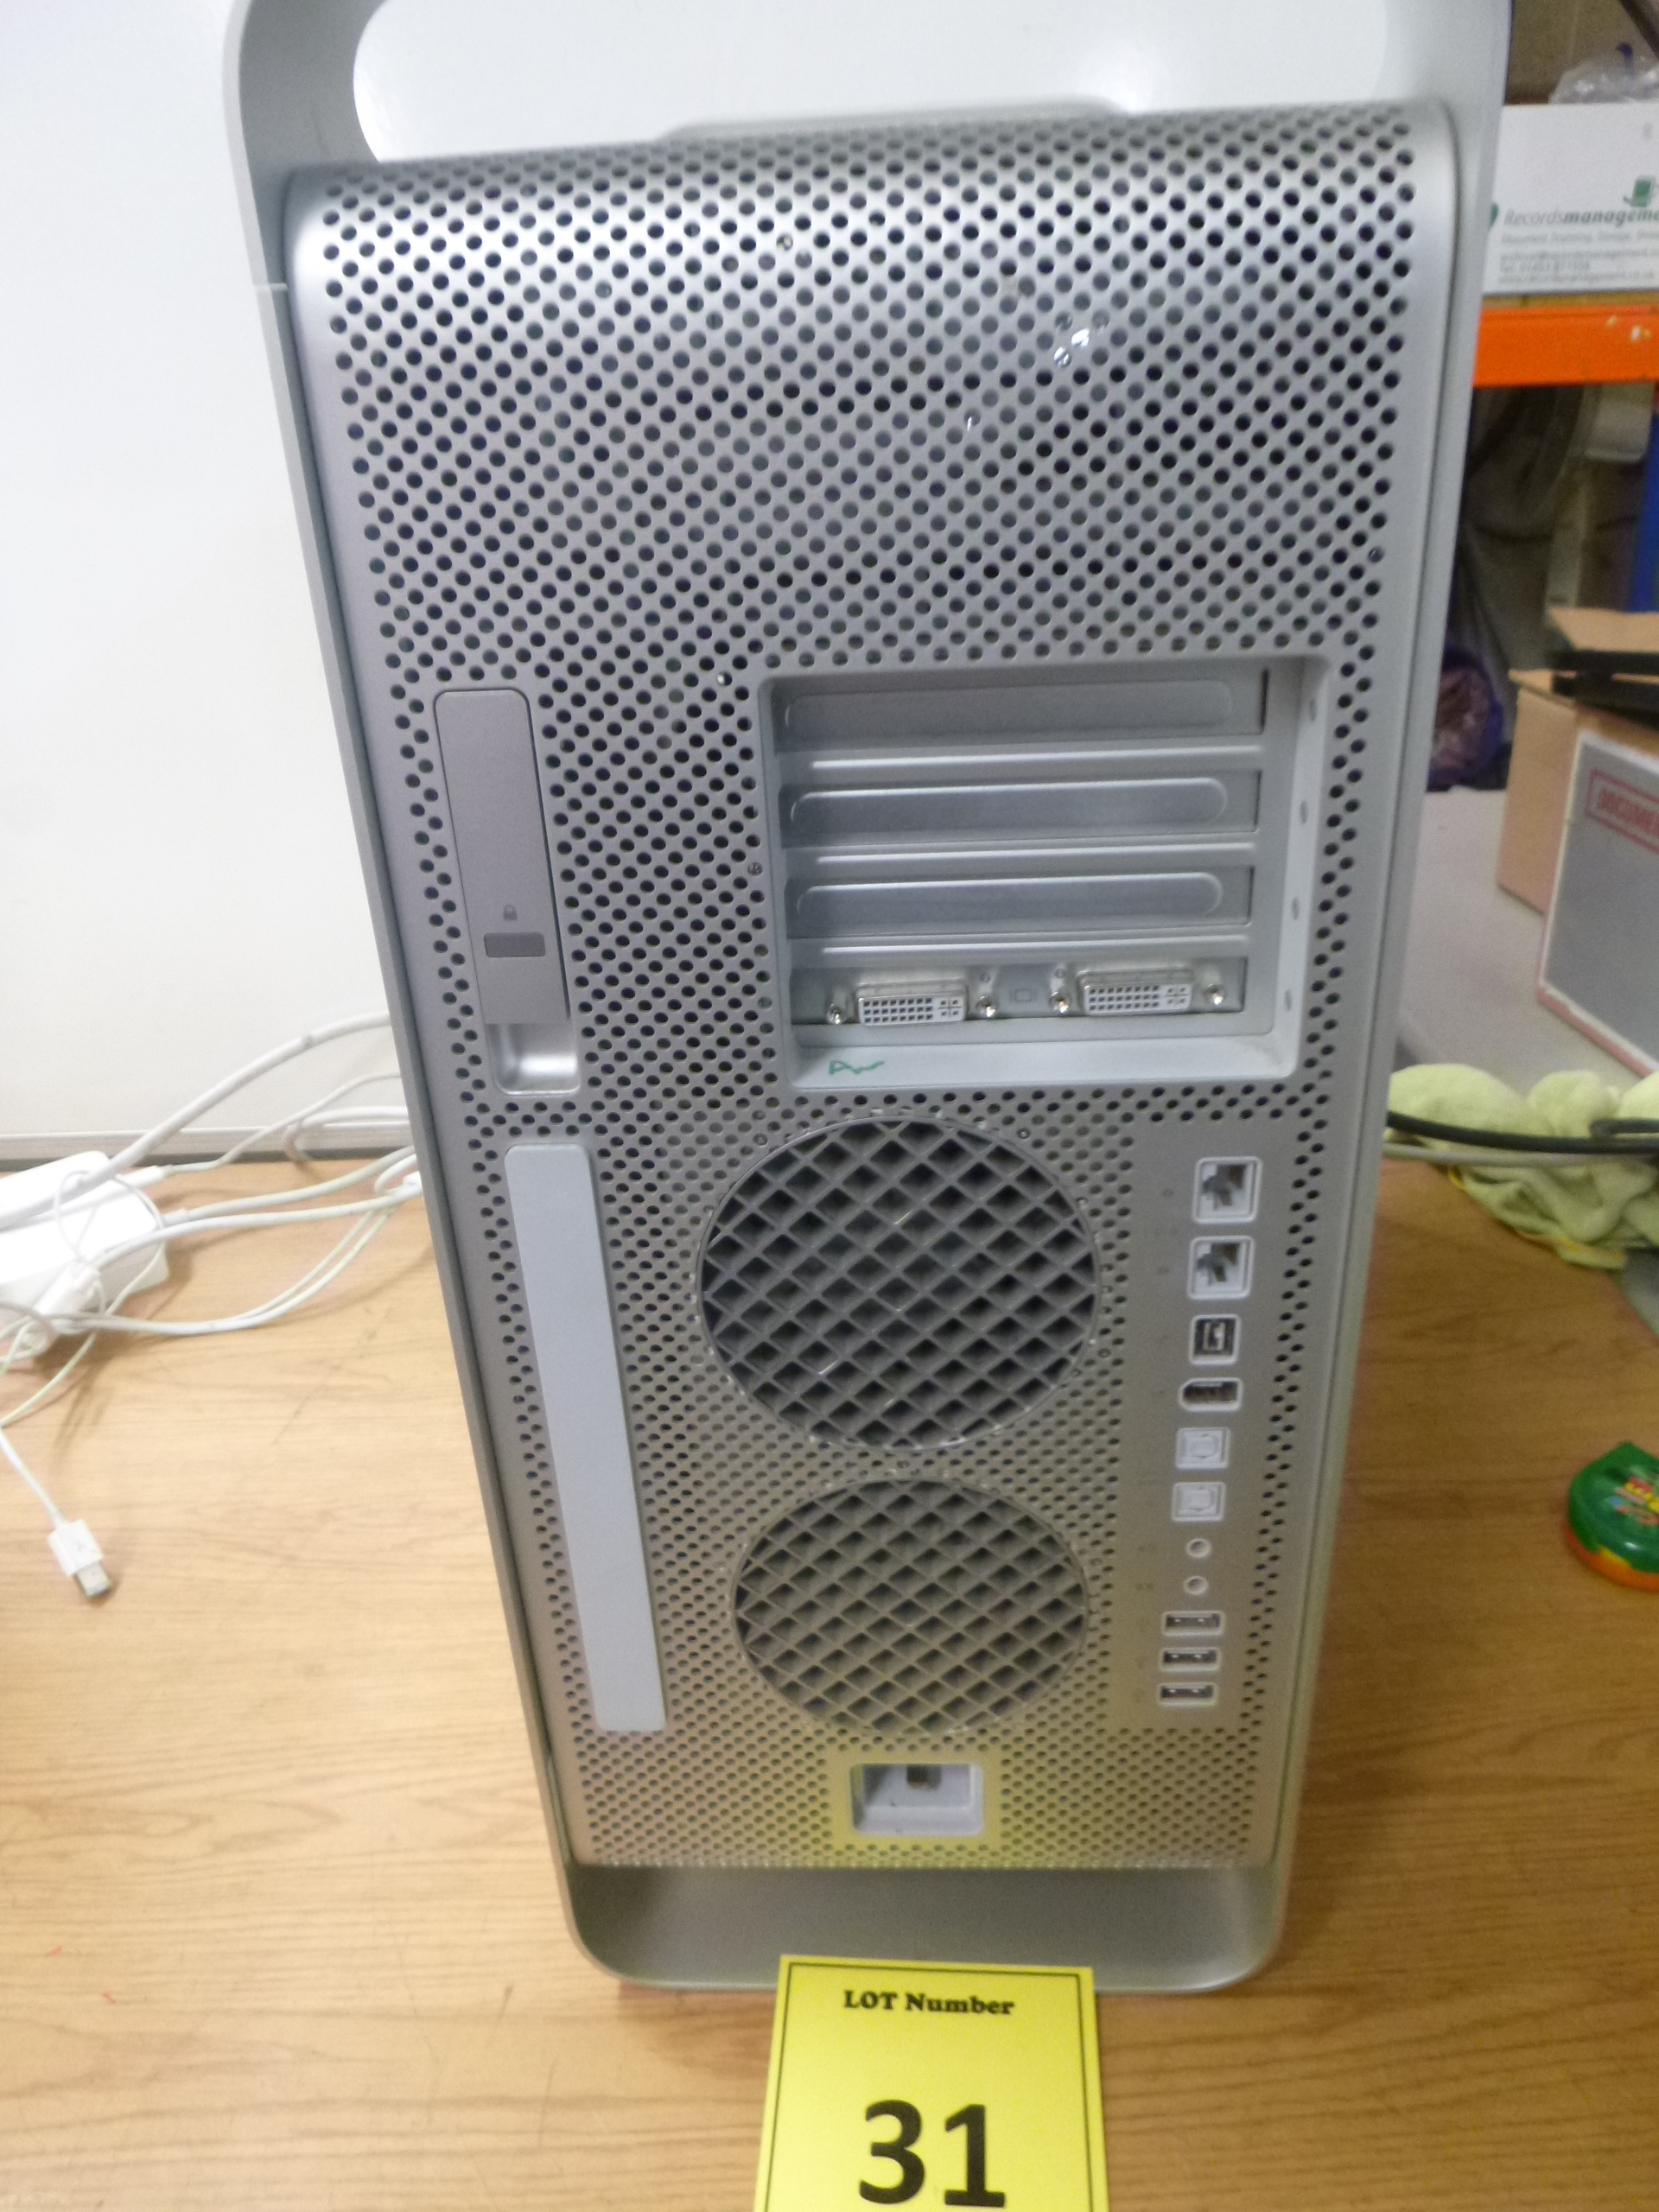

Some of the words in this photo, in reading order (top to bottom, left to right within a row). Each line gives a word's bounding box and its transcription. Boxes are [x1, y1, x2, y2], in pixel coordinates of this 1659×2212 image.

[844, 1990, 898, 2010] LOT
[906, 1993, 1014, 2015] Number
[859, 2099, 1006, 2209] 31
